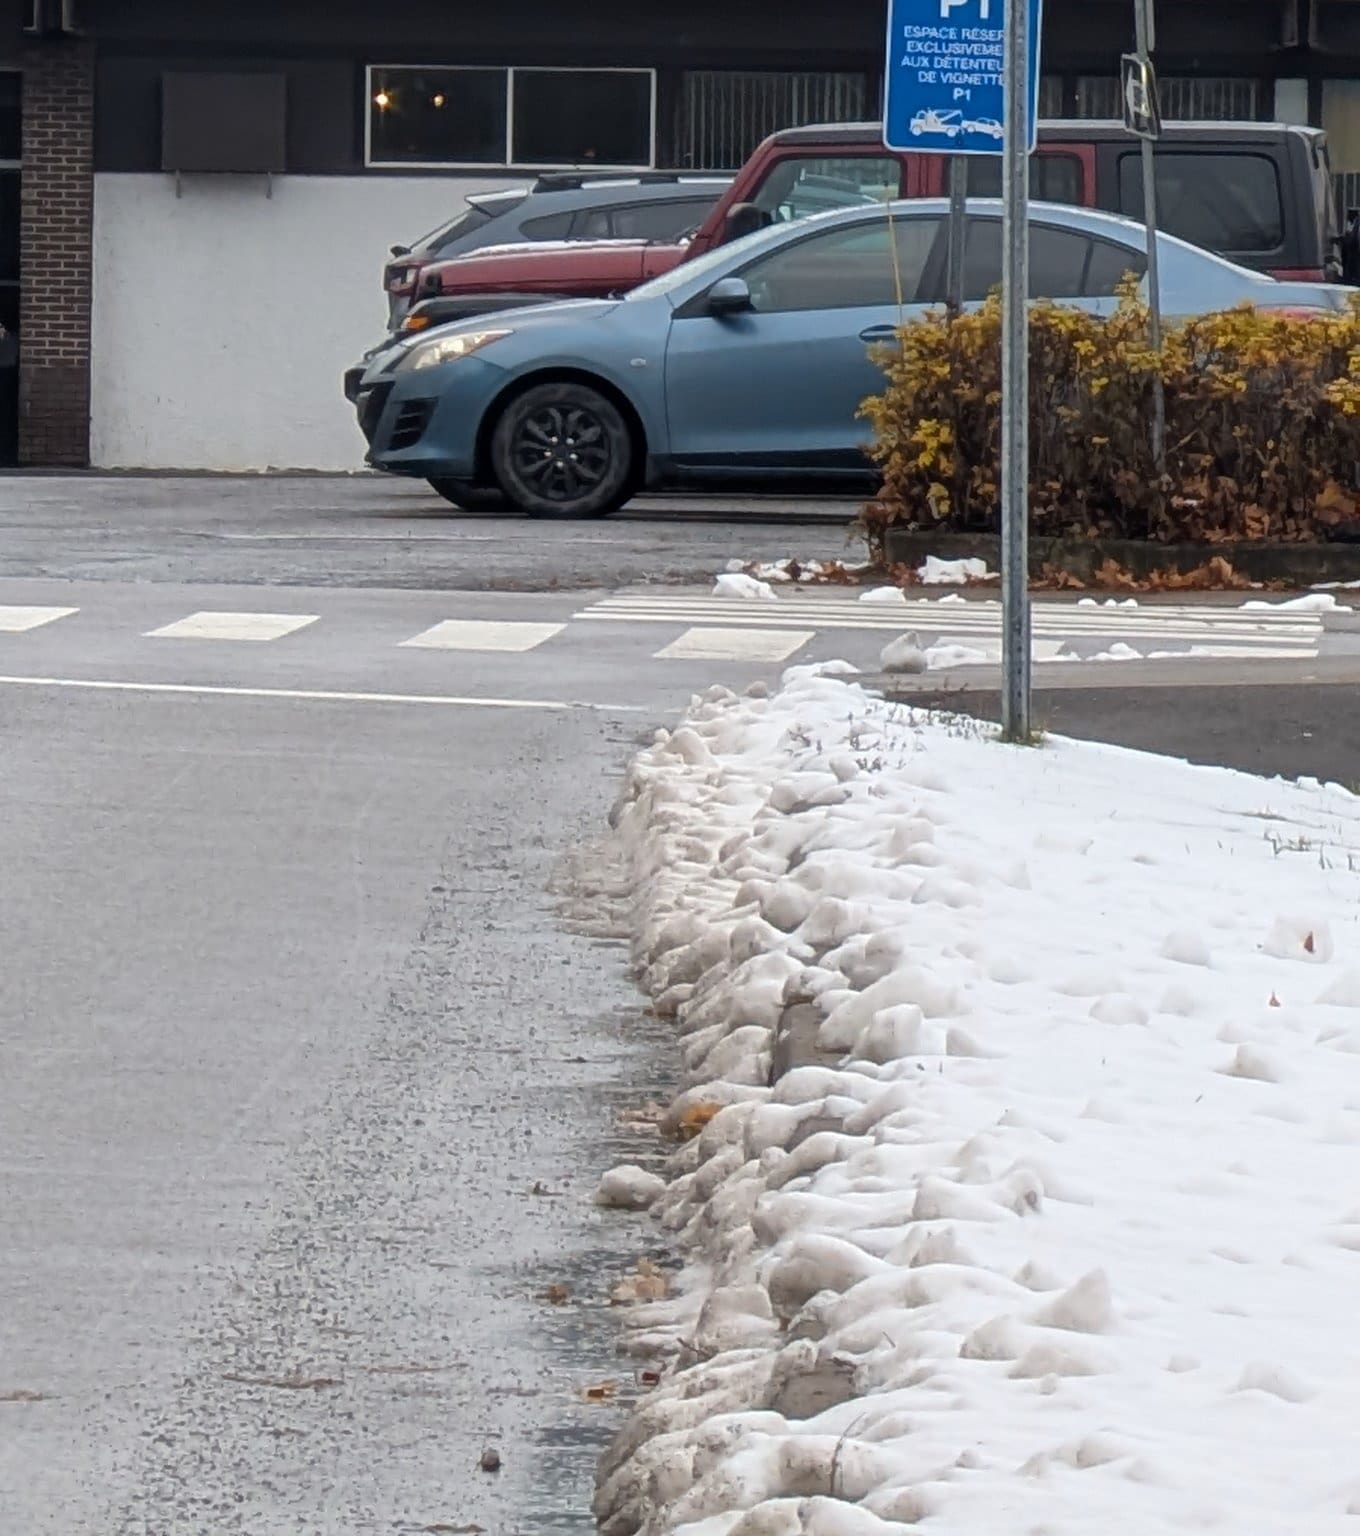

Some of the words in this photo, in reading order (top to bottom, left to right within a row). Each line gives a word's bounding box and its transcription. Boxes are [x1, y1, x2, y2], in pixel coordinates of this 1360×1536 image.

[903, 25, 958, 40] ESPACE
[961, 26, 1005, 42] RÉSER
[906, 40, 1003, 57] EXCLUSIVEME
[901, 55, 930, 68] AUX
[933, 55, 1005, 72] DÉTENTEU
[918, 70, 937, 84] DE
[952, 87, 972, 102] P1
